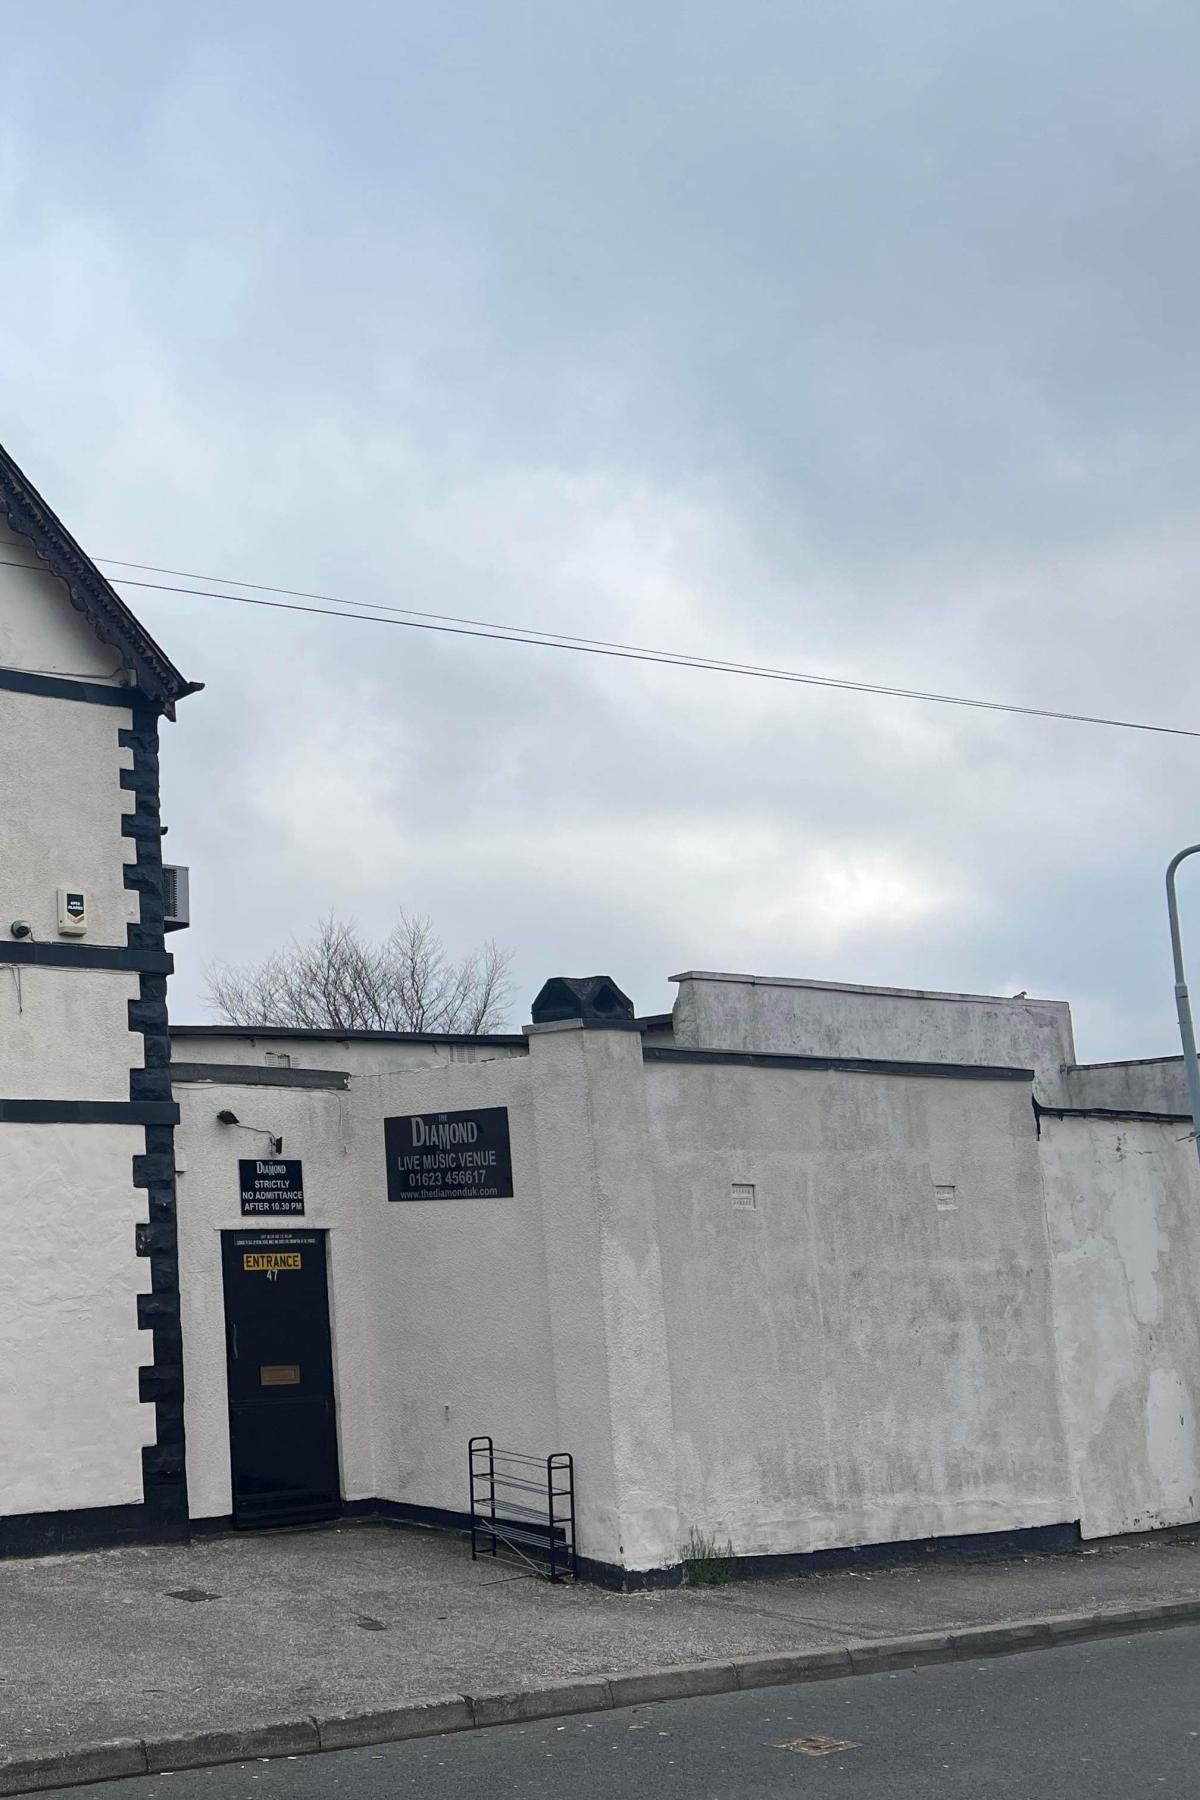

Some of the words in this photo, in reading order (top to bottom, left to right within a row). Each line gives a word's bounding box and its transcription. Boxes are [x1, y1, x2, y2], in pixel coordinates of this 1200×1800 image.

[398, 1155, 421, 1171] LIVE
[423, 1152, 457, 1170] MUSIC
[458, 1150, 497, 1168] VENUE
[409, 1172, 443, 1187] 01623
[445, 1169, 486, 1185] 456617
[254, 1180, 290, 1189] STRICTLY
[242, 1191, 254, 1200] NO
[255, 1191, 303, 1200] ADMITTANCE
[400, 1186, 498, 1200] www.thediamonduk.com
[244, 1202, 270, 1211] AFTER
[271, 1202, 290, 1211] 10.30
[291, 1202, 303, 1210] PM
[245, 1255, 299, 1268] ENTRANCE
[266, 1269, 279, 1281] 47
